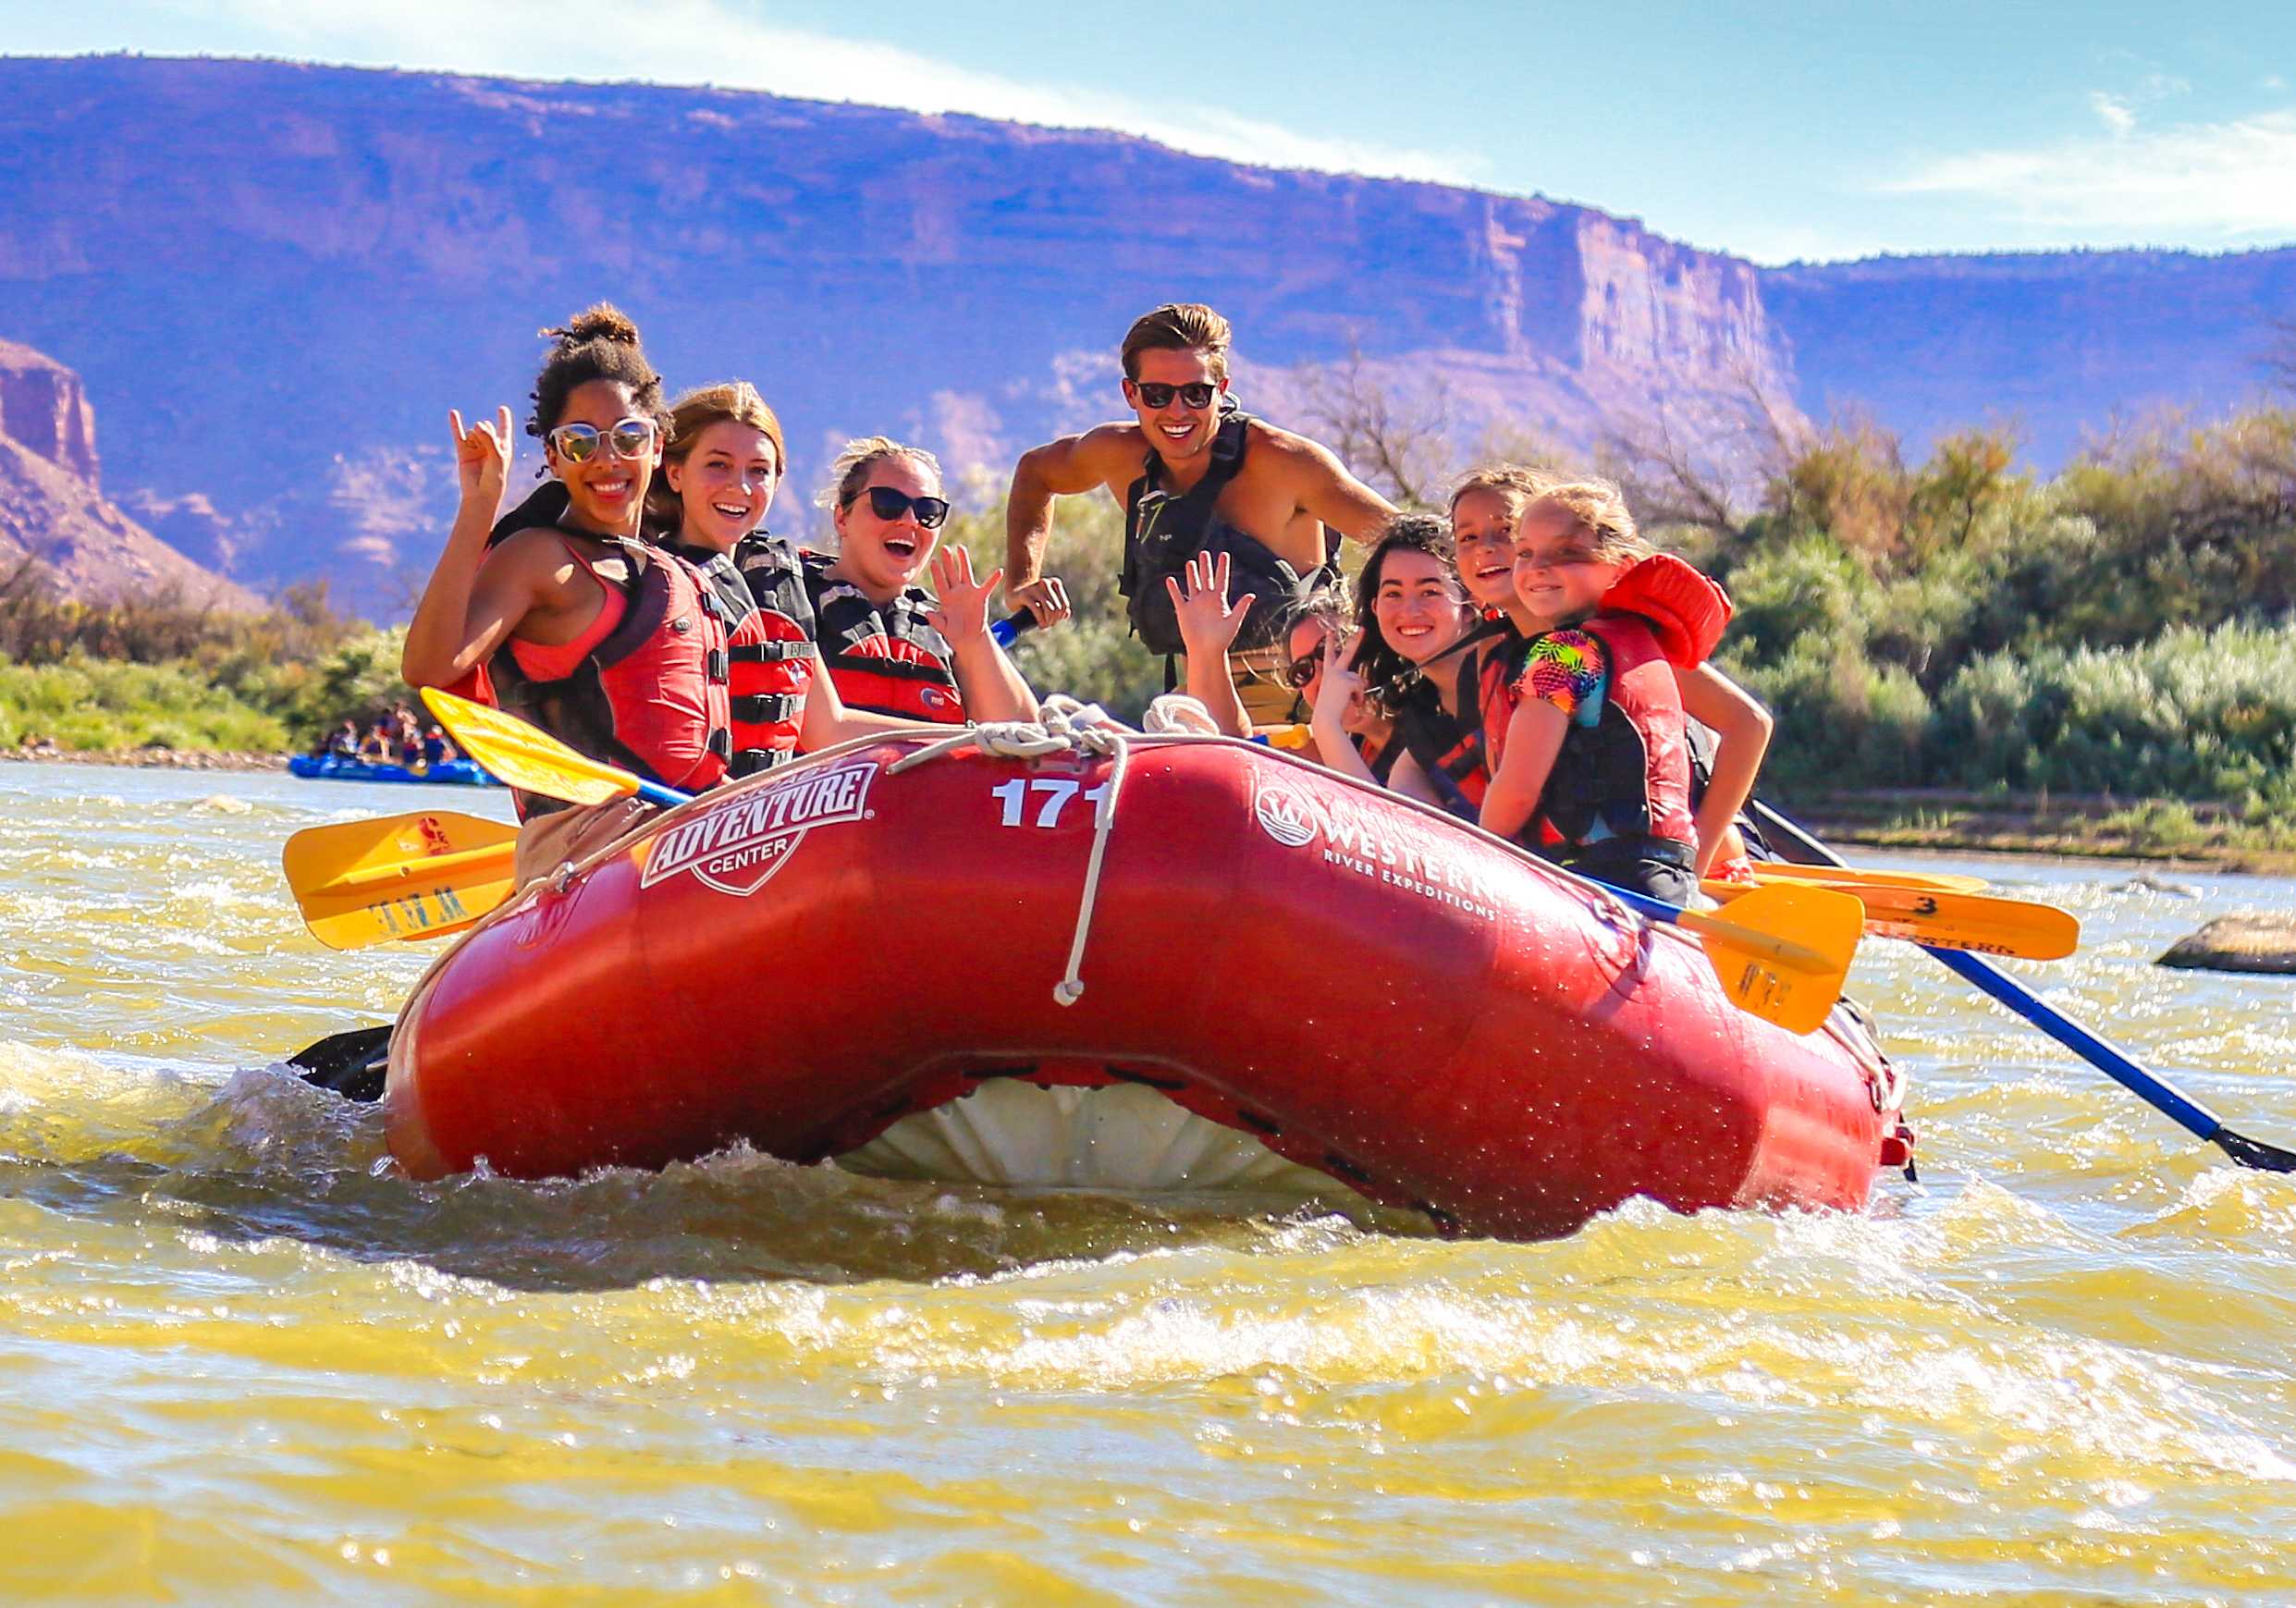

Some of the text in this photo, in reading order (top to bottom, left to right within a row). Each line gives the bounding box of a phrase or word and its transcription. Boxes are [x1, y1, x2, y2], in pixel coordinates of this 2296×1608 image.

[649, 768, 864, 877] ADVENTURE
[991, 778, 1113, 829] 171
[708, 838, 788, 874] CENTER
[1322, 813, 1503, 907] WESTERN
[1323, 848, 1496, 922] RIVER EXPEDITIONS
